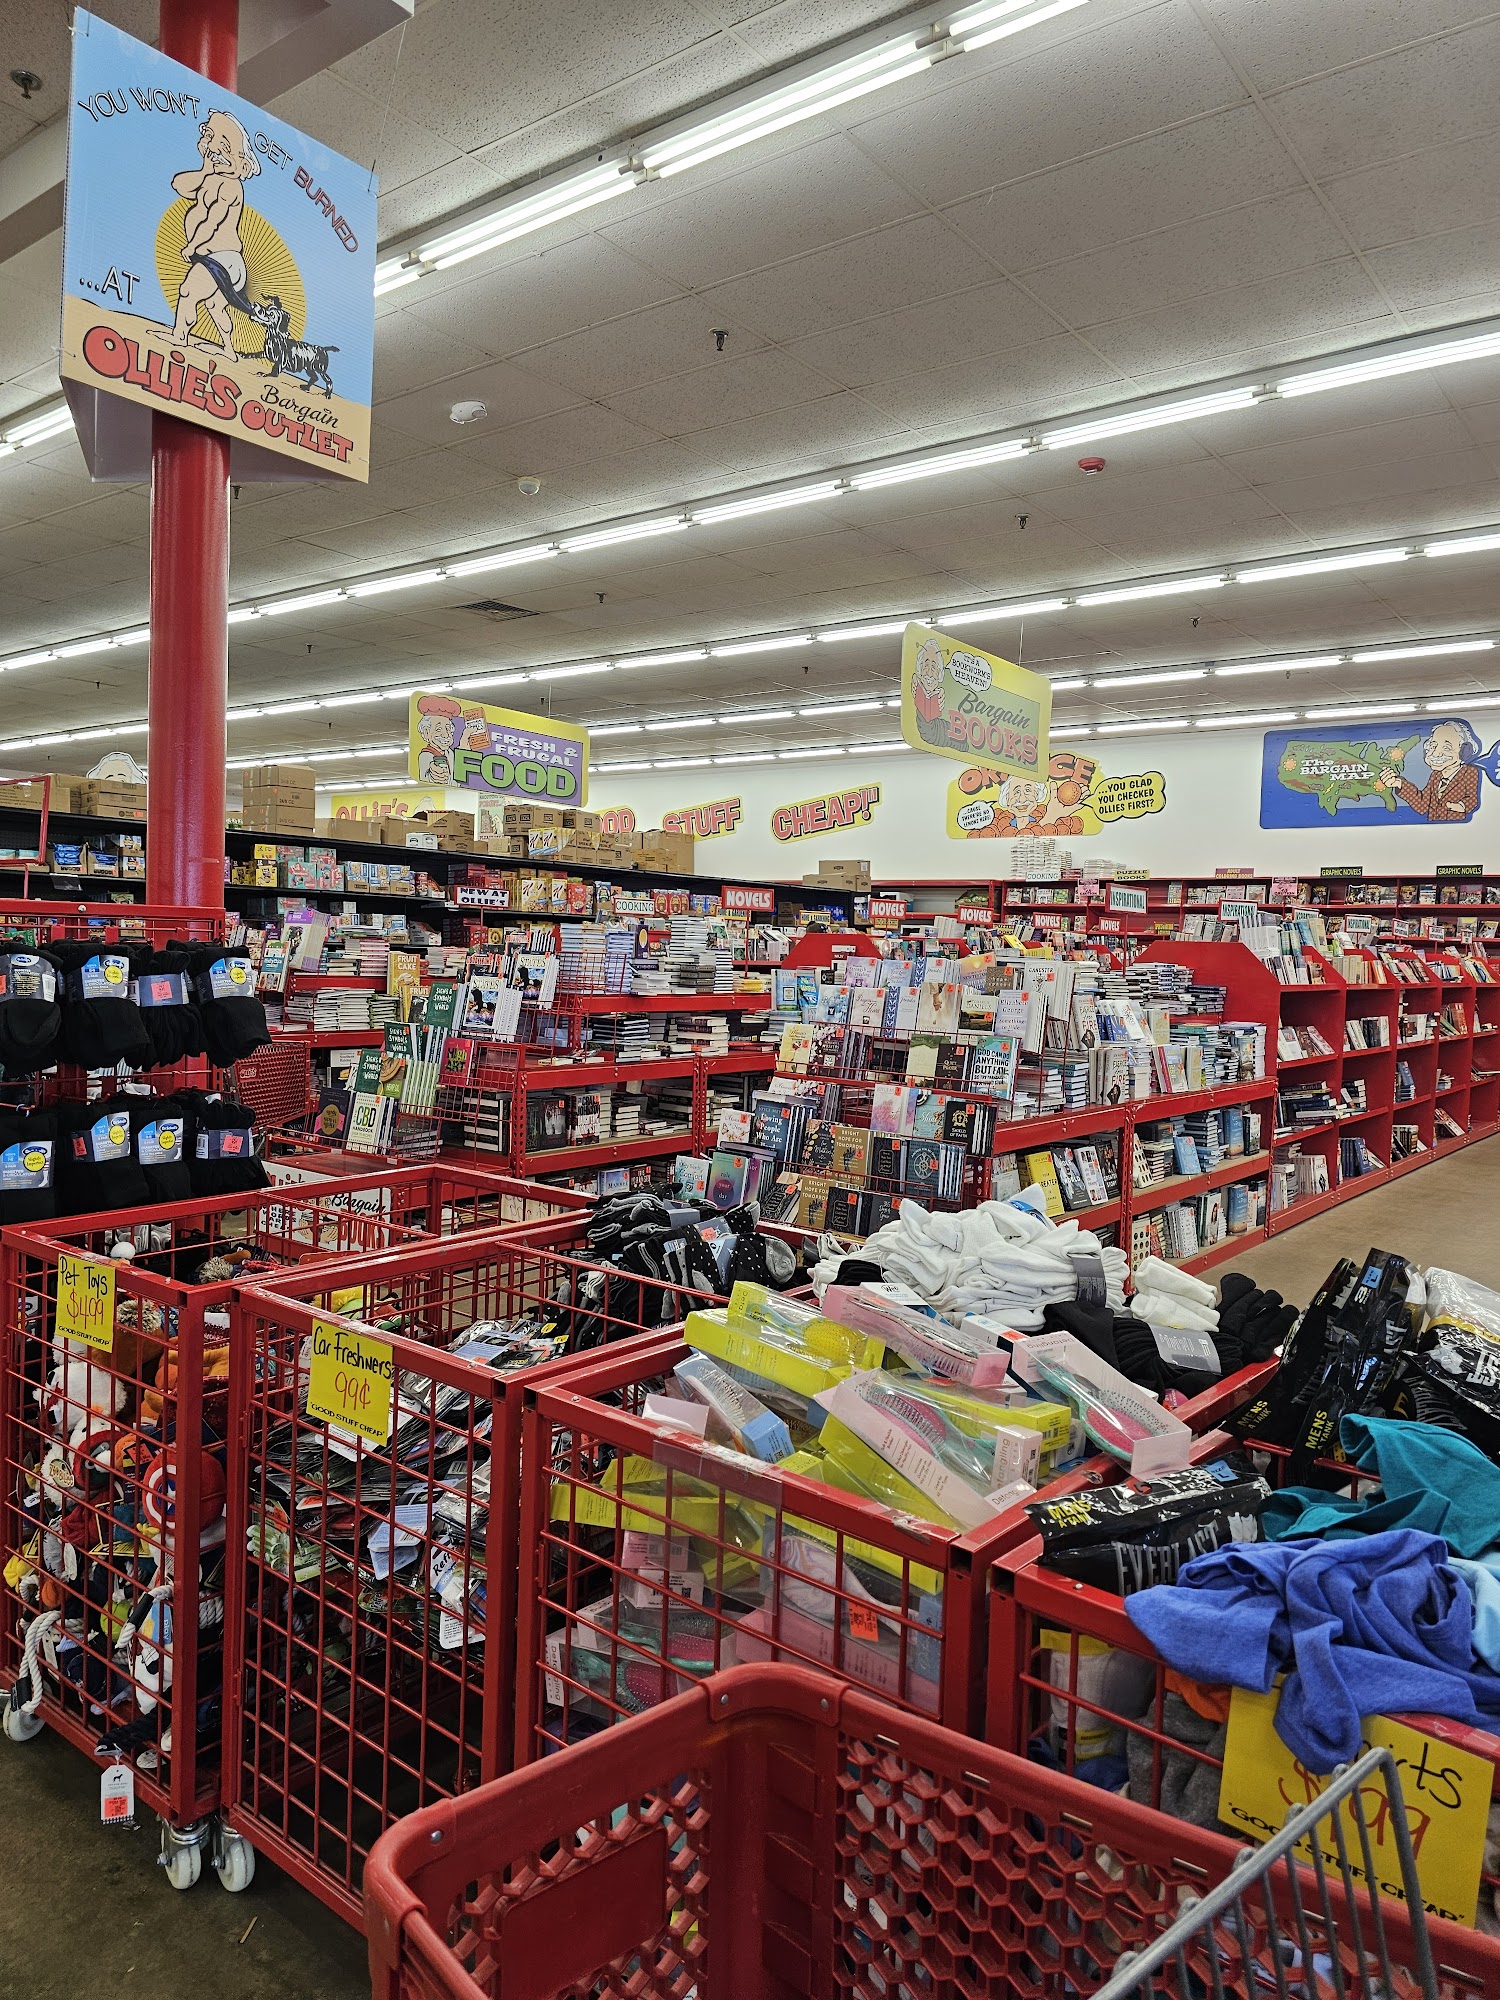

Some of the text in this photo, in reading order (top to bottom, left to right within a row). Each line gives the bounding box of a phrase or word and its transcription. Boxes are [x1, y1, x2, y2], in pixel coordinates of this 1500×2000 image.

[78, 87, 359, 253] YOU WON'T GET BURNED
[261, 384, 339, 428] Bargain
[241, 400, 353, 464] OUTLET
[952, 658, 991, 680] BOOKWORM'S
[954, 669, 988, 689] HEAVEN!
[957, 689, 1031, 730] Bargain
[947, 709, 1039, 765] BOOKS
[491, 731, 578, 758] FRESH &
[495, 744, 574, 767] FRUGAL
[1300, 763, 1369, 775] BARGAIN
[1301, 759, 1334, 767] The
[453, 749, 578, 798] FOOD
[1329, 771, 1375, 781] MAP
[1130, 779, 1152, 789] GLAD
[1098, 789, 1154, 804] YOU CHECKED
[1099, 798, 1154, 814] OLLIES FIRST?
[662, 798, 741, 837] STUFF
[1027, 872, 1059, 880] COOKING
[1321, 868, 1342, 876] GRAPHIC
[1438, 867, 1482, 875] GRAPHIC NOVELS
[460, 888, 507, 898] NEW AT
[726, 890, 771, 908] NOVELS
[1111, 891, 1145, 909] INSPIRATIONAL
[461, 897, 506, 906] OLLIE'S
[615, 900, 654, 912] COOKING
[871, 901, 905, 917] NOVELS
[960, 909, 993, 923] NOVELS
[1035, 914, 1060, 927] NOVELS
[1100, 918, 1120, 932] NOVELS
[398, 963, 417, 971] CAKE
[434, 1003, 450, 1011] WORLD
[1082, 1020, 1097, 1030] FIRE
[388, 1035, 408, 1044] SYMBOLS
[392, 1044, 407, 1052] WORLD
[976, 1056, 1009, 1066] ANYTHING
[975, 1064, 992, 1074] BUT
[356, 1105, 377, 1127] CBD
[761, 1112, 783, 1125] Loving
[760, 1123, 780, 1133] People
[756, 1132, 782, 1143] Who Are
[836, 1142, 864, 1150] TOMORROW
[809, 1180, 827, 1188] BRIGHT
[60, 1256, 108, 1299] Pet Toys
[76, 1331, 92, 1340] STUFF
[313, 1326, 331, 1356] Car
[335, 1371, 371, 1411] 99¢
[336, 1414, 359, 1427] STUFF
[1236, 1400, 1269, 1427] MENS
[1253, 1408, 1272, 1425] TANK
[1305, 1410, 1328, 1450] MENS
[1320, 1419, 1335, 1444] TANK
[997, 1438, 1011, 1489] etangling
[1047, 1498, 1092, 1521] MENS
